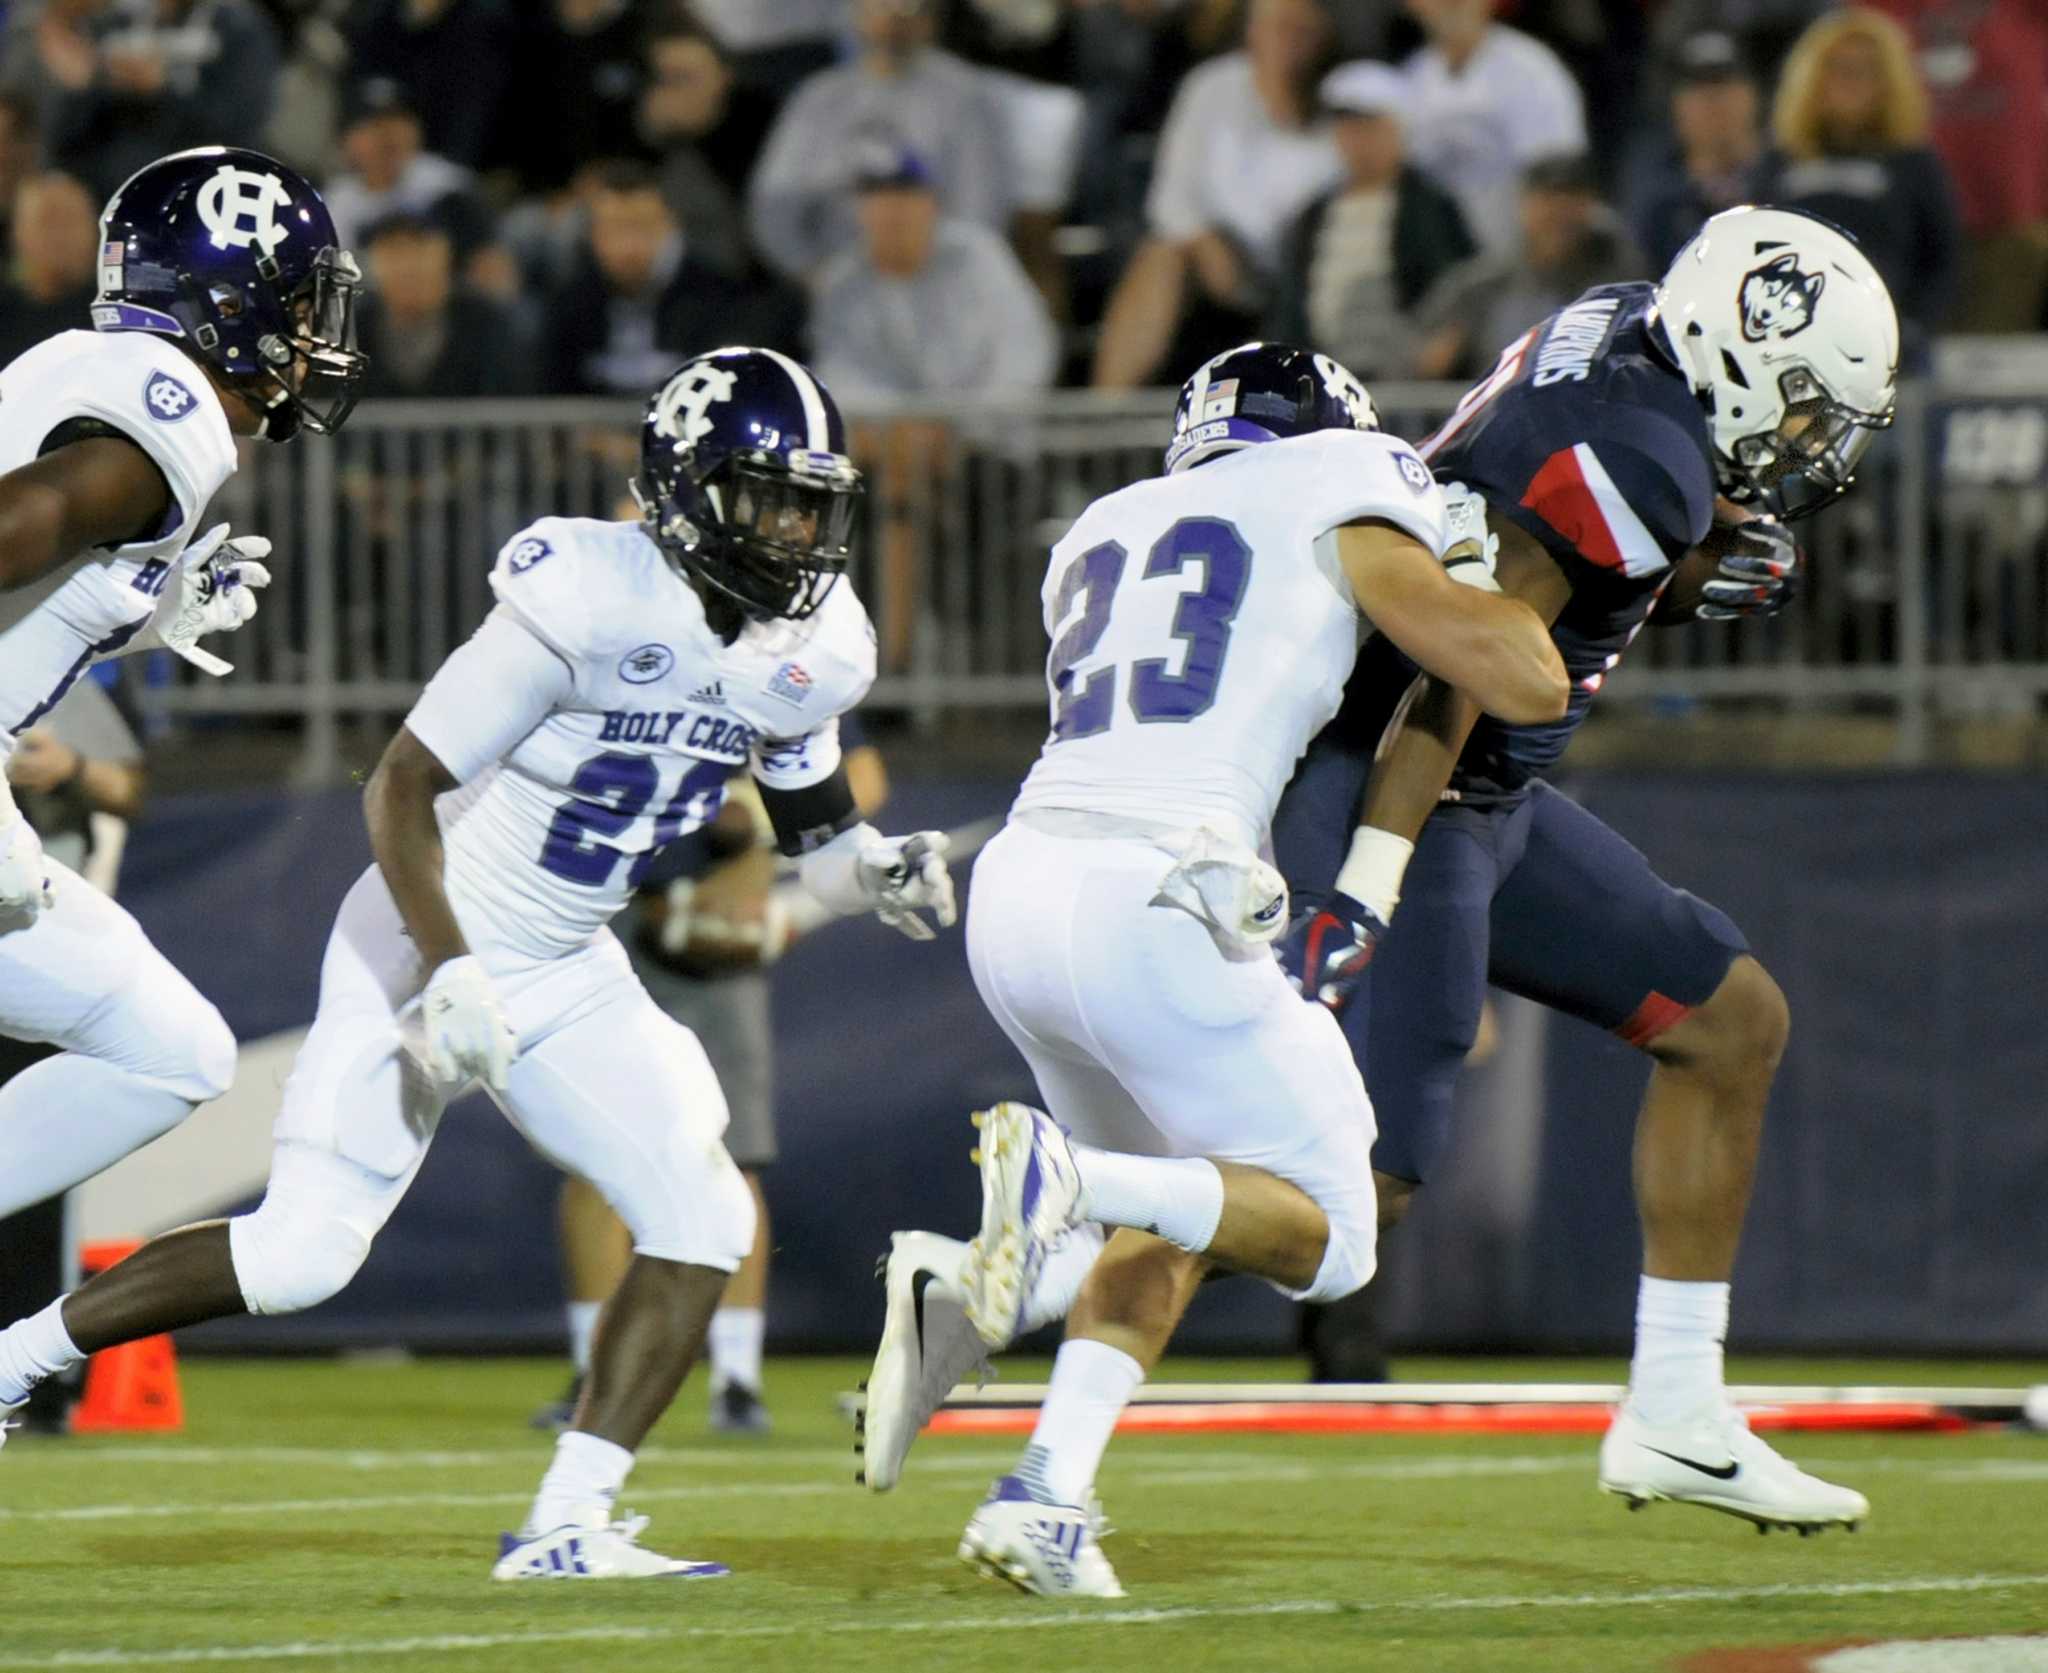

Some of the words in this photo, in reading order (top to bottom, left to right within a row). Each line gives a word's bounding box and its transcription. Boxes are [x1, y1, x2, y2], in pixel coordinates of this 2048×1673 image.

[1051, 515, 1254, 744] 23
[597, 710, 684, 744] HOLY
[687, 716, 760, 756] CROS
